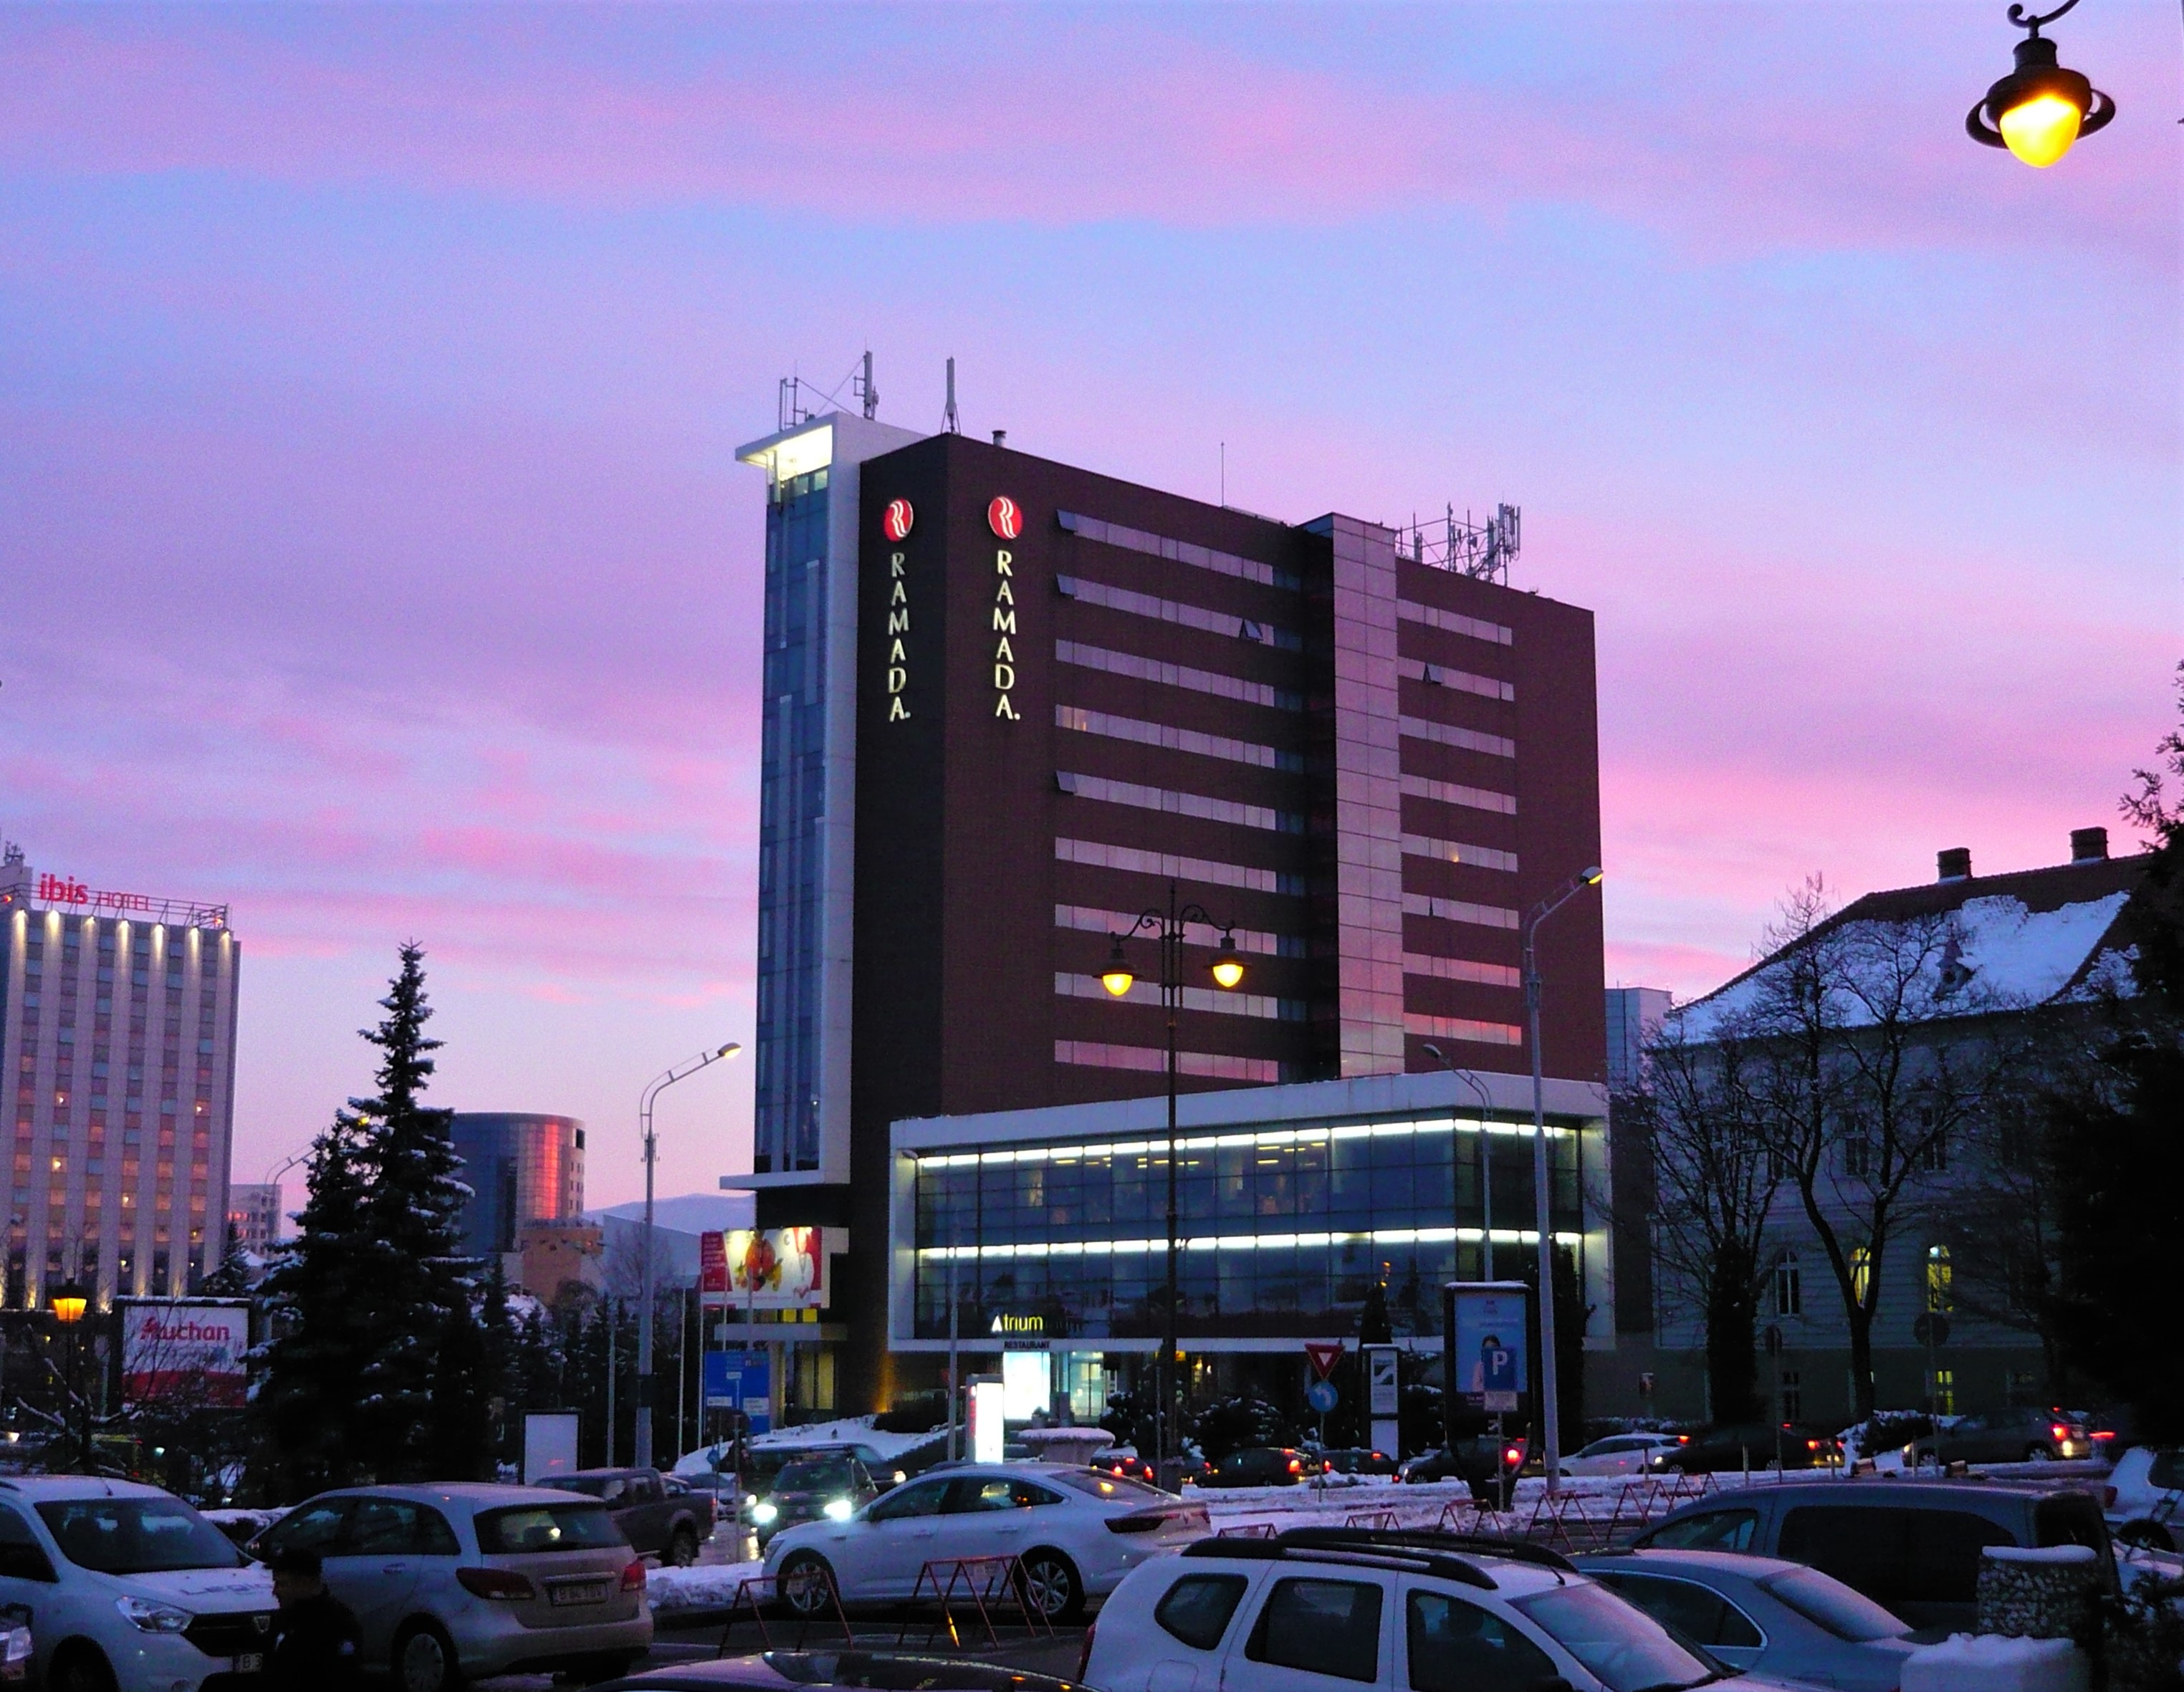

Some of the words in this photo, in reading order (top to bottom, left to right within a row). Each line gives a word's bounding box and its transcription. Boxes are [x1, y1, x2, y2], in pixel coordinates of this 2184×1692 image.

[39, 873, 88, 904] ibis
[97, 891, 149, 910] HOTEL
[140, 1317, 230, 1340] Auchan
[1005, 1340, 1050, 1349] RESTAURANT
[1493, 1350, 1508, 1375] P
